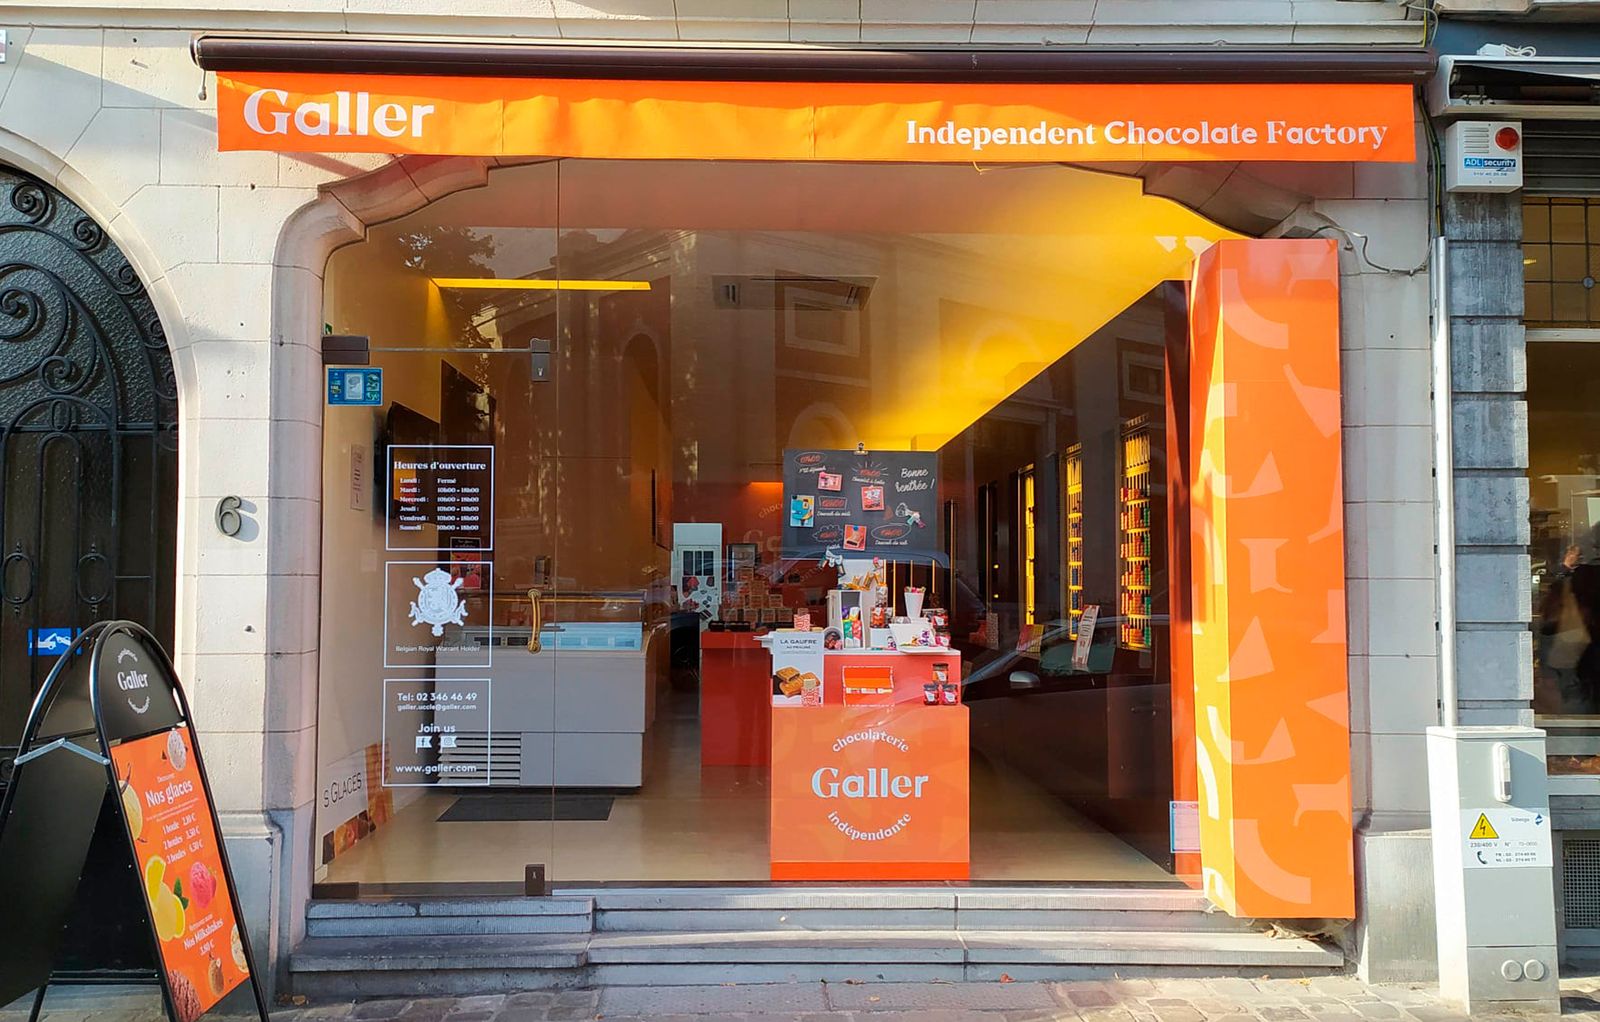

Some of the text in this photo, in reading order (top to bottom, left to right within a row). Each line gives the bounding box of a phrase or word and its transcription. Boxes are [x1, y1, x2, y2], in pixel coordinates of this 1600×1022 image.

[244, 88, 435, 137] Galler
[905, 119, 1388, 150] Independent Chocolate Factory
[1465, 158, 1515, 167] ADL security
[394, 461, 486, 470] Heures d'ouverture
[901, 468, 928, 478] Bonne
[215, 495, 242, 536] 6
[117, 670, 148, 691] Galler
[397, 692, 477, 701] Tel: 02 346 46 49
[397, 703, 476, 711] galler.uccle@galler.com
[418, 723, 440, 733] Join
[832, 728, 909, 752] chocolaterie
[396, 764, 477, 774] www.galler.com
[145, 780, 193, 807] Nos glaces
[331, 772, 362, 803] GLACES
[812, 767, 929, 798] Galler
[828, 811, 912, 841] indépendante
